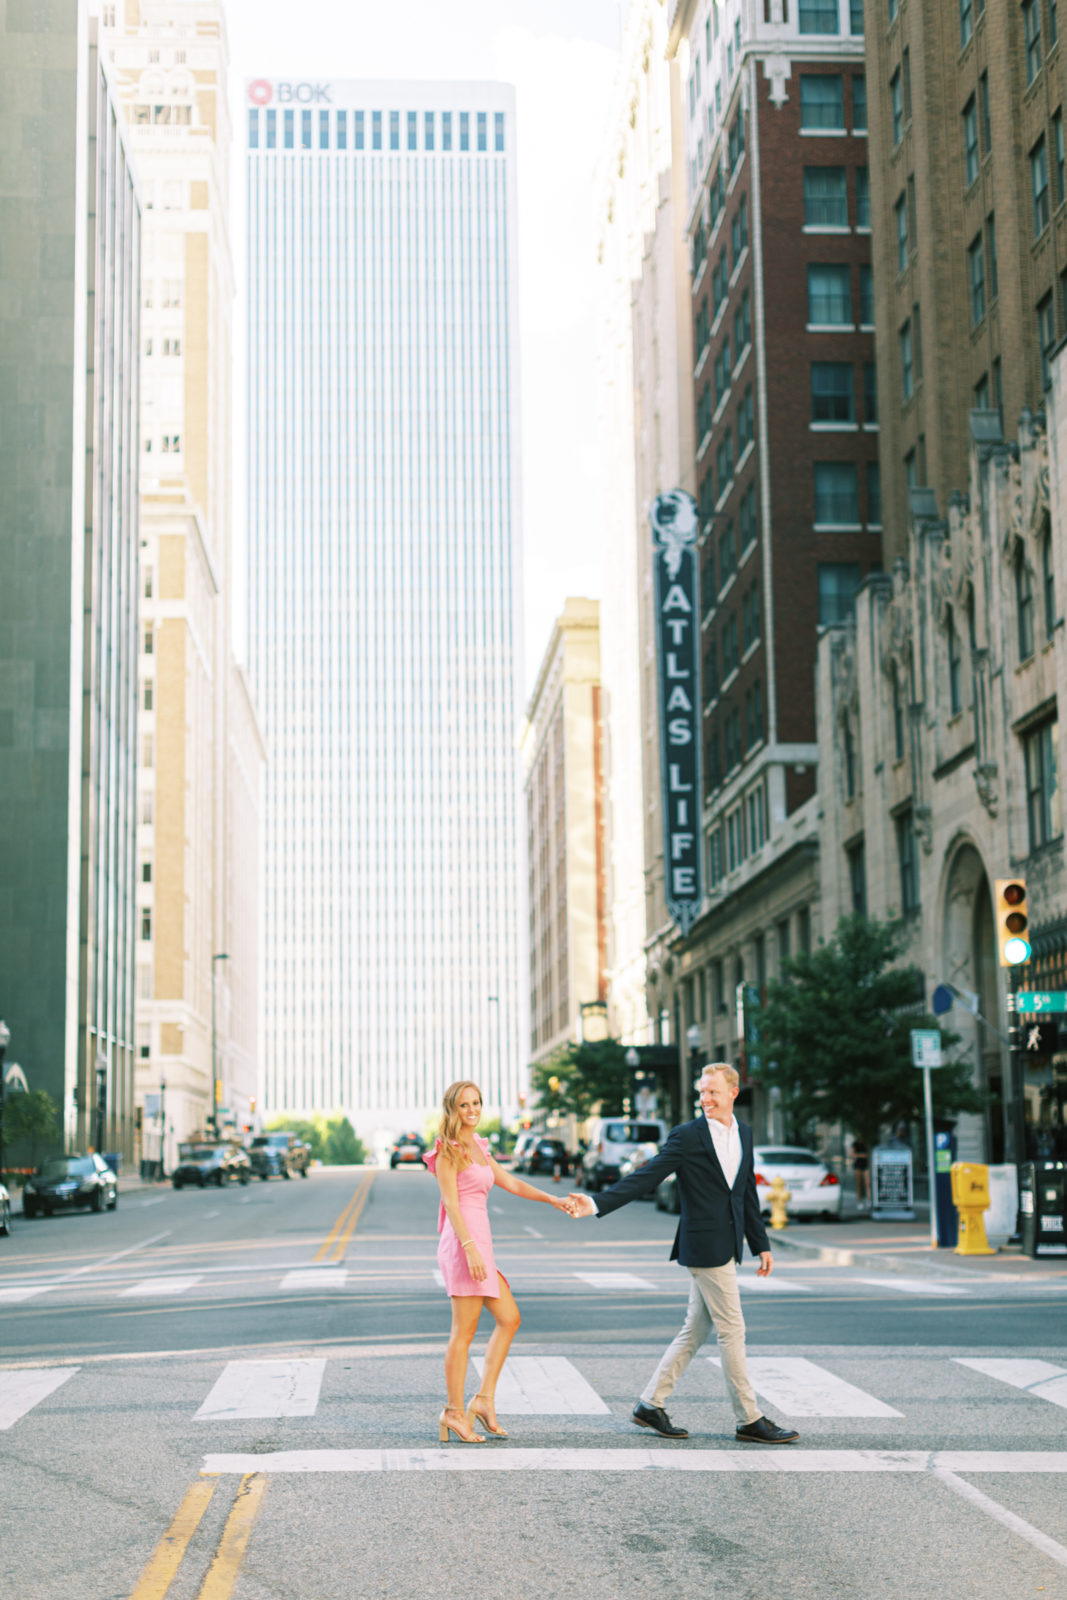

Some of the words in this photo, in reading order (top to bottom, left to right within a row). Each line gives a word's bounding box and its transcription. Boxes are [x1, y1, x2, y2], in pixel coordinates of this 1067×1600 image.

[278, 83, 333, 104] BOK
[662, 584, 692, 745] ATLAS
[669, 763, 696, 894] LIFE
